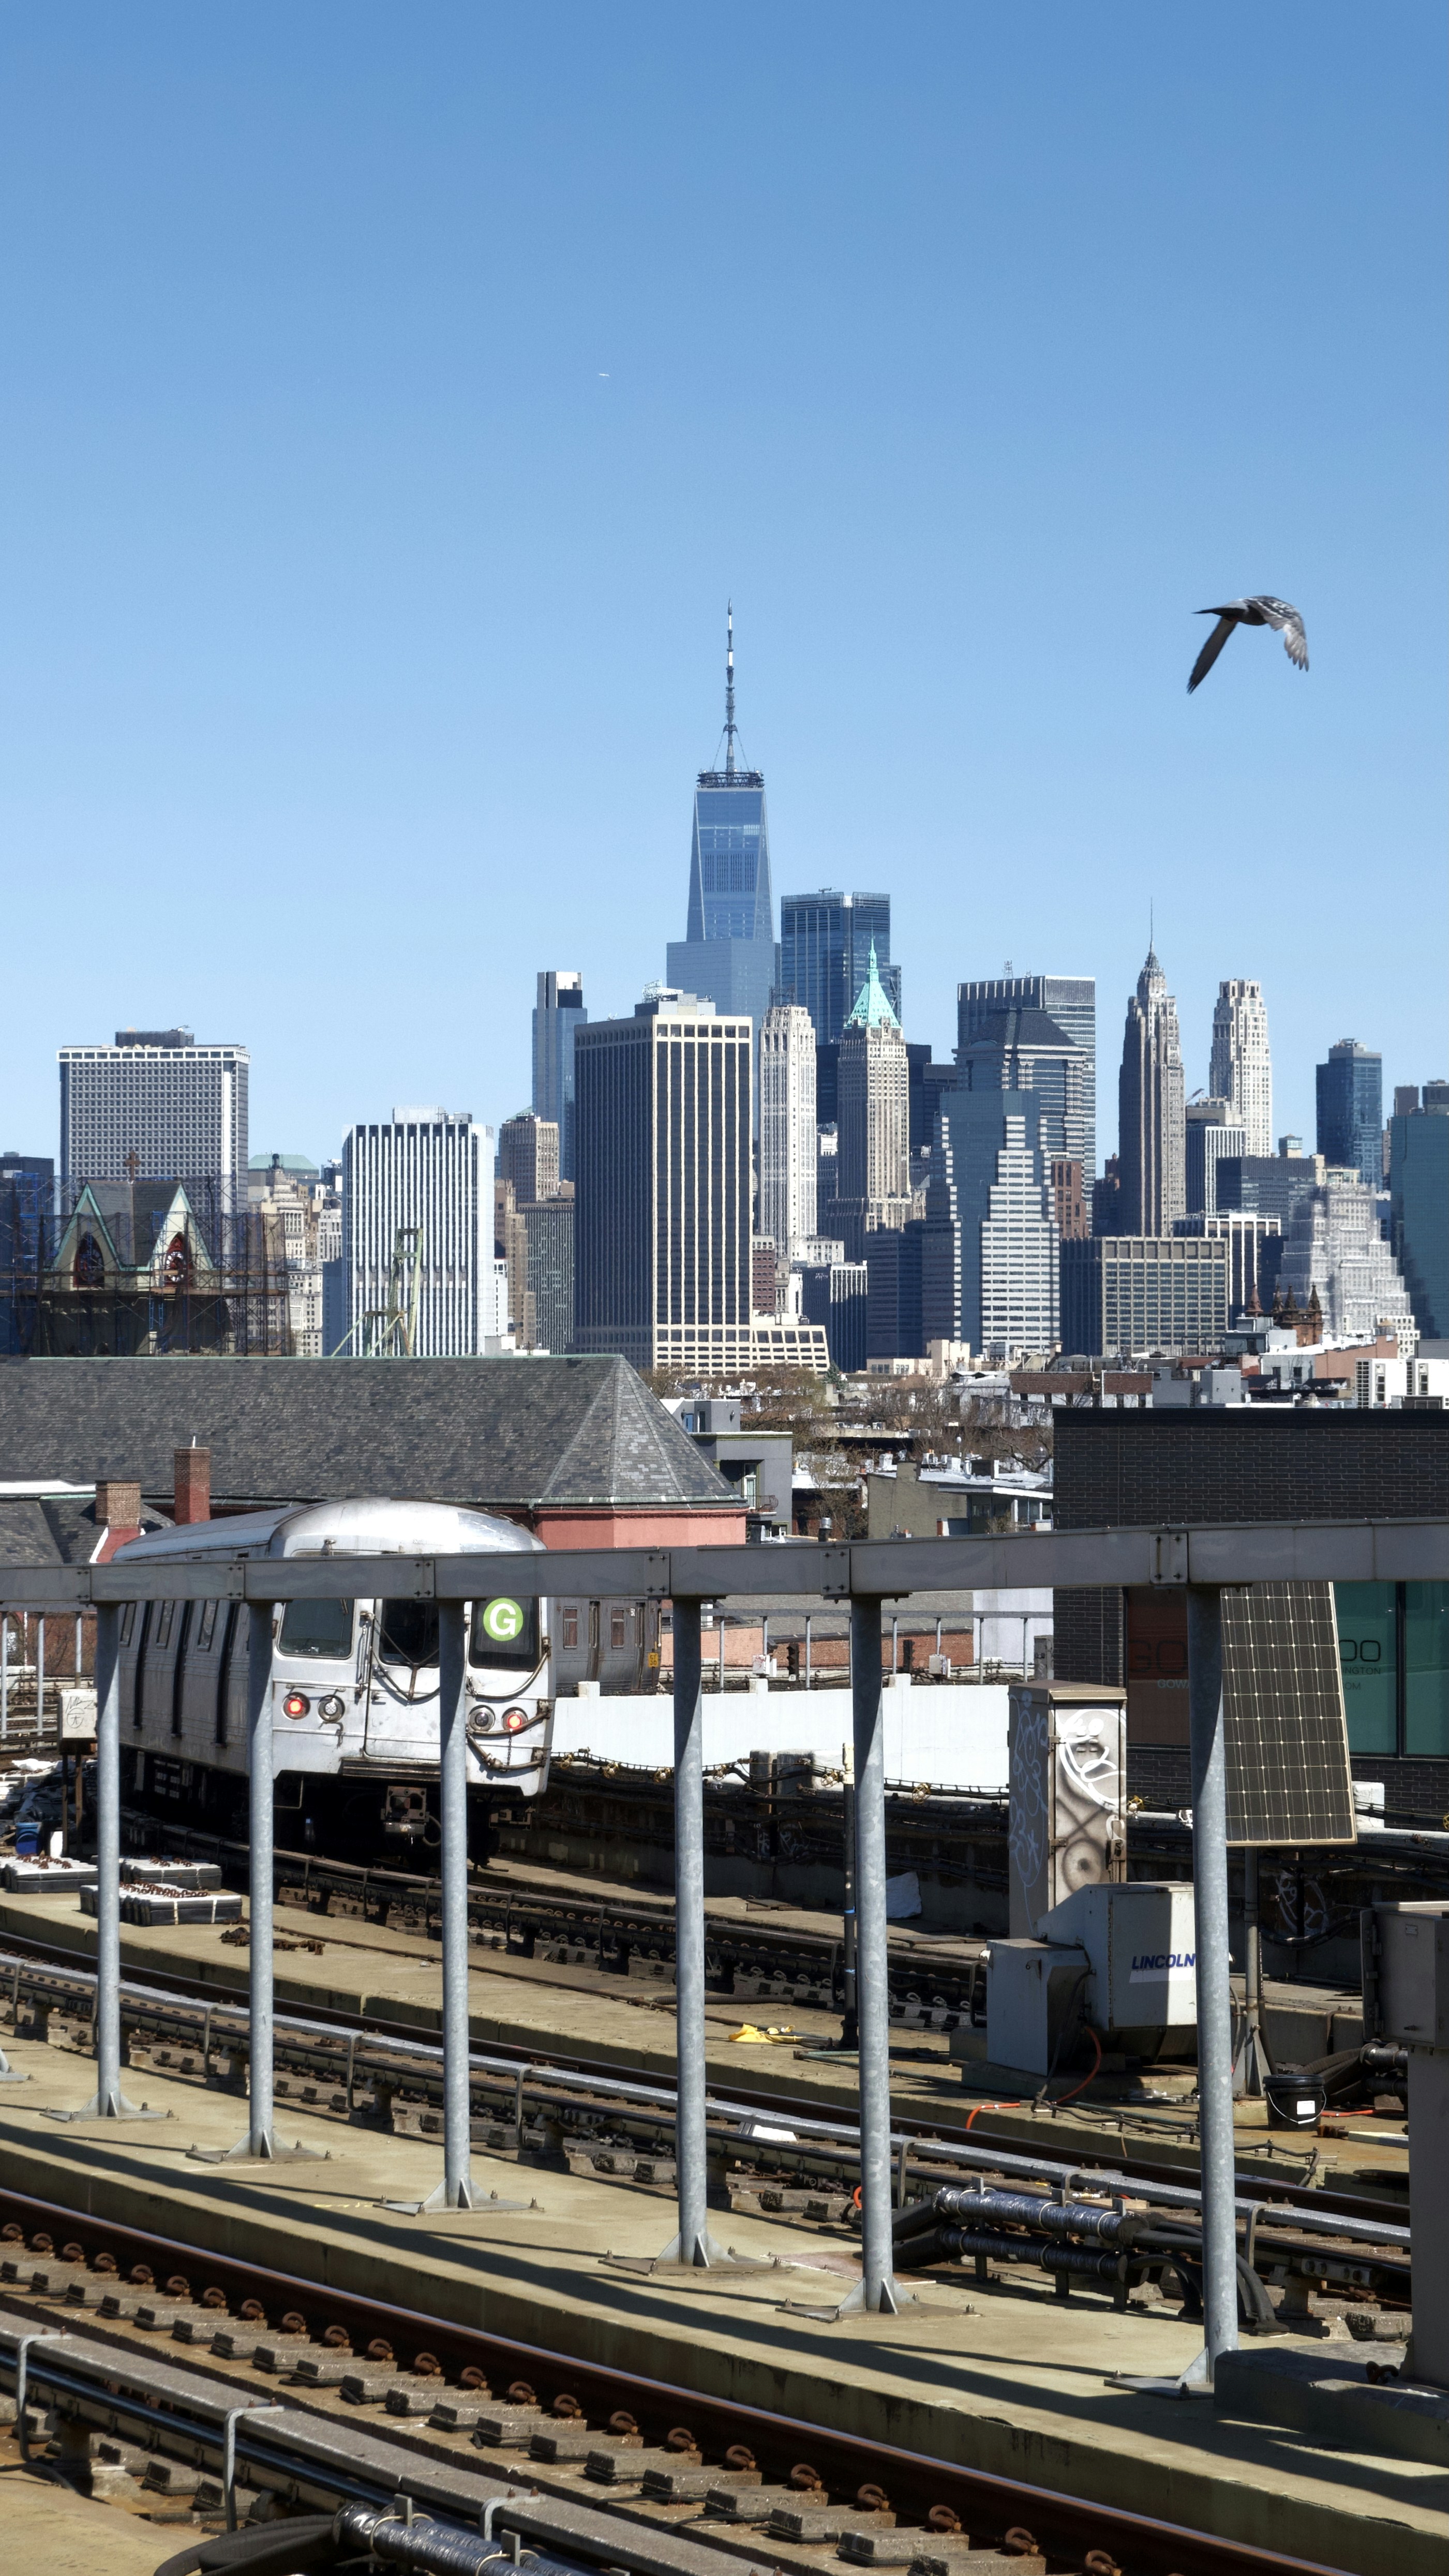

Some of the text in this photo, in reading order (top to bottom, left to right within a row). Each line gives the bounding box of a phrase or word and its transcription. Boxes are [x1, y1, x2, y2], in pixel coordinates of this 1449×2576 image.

[490, 1603, 516, 1635] G
[1342, 1666, 1381, 1675] INGTON
[1343, 1682, 1361, 1690] OM
[1132, 1953, 1196, 1970] LINCOLN
